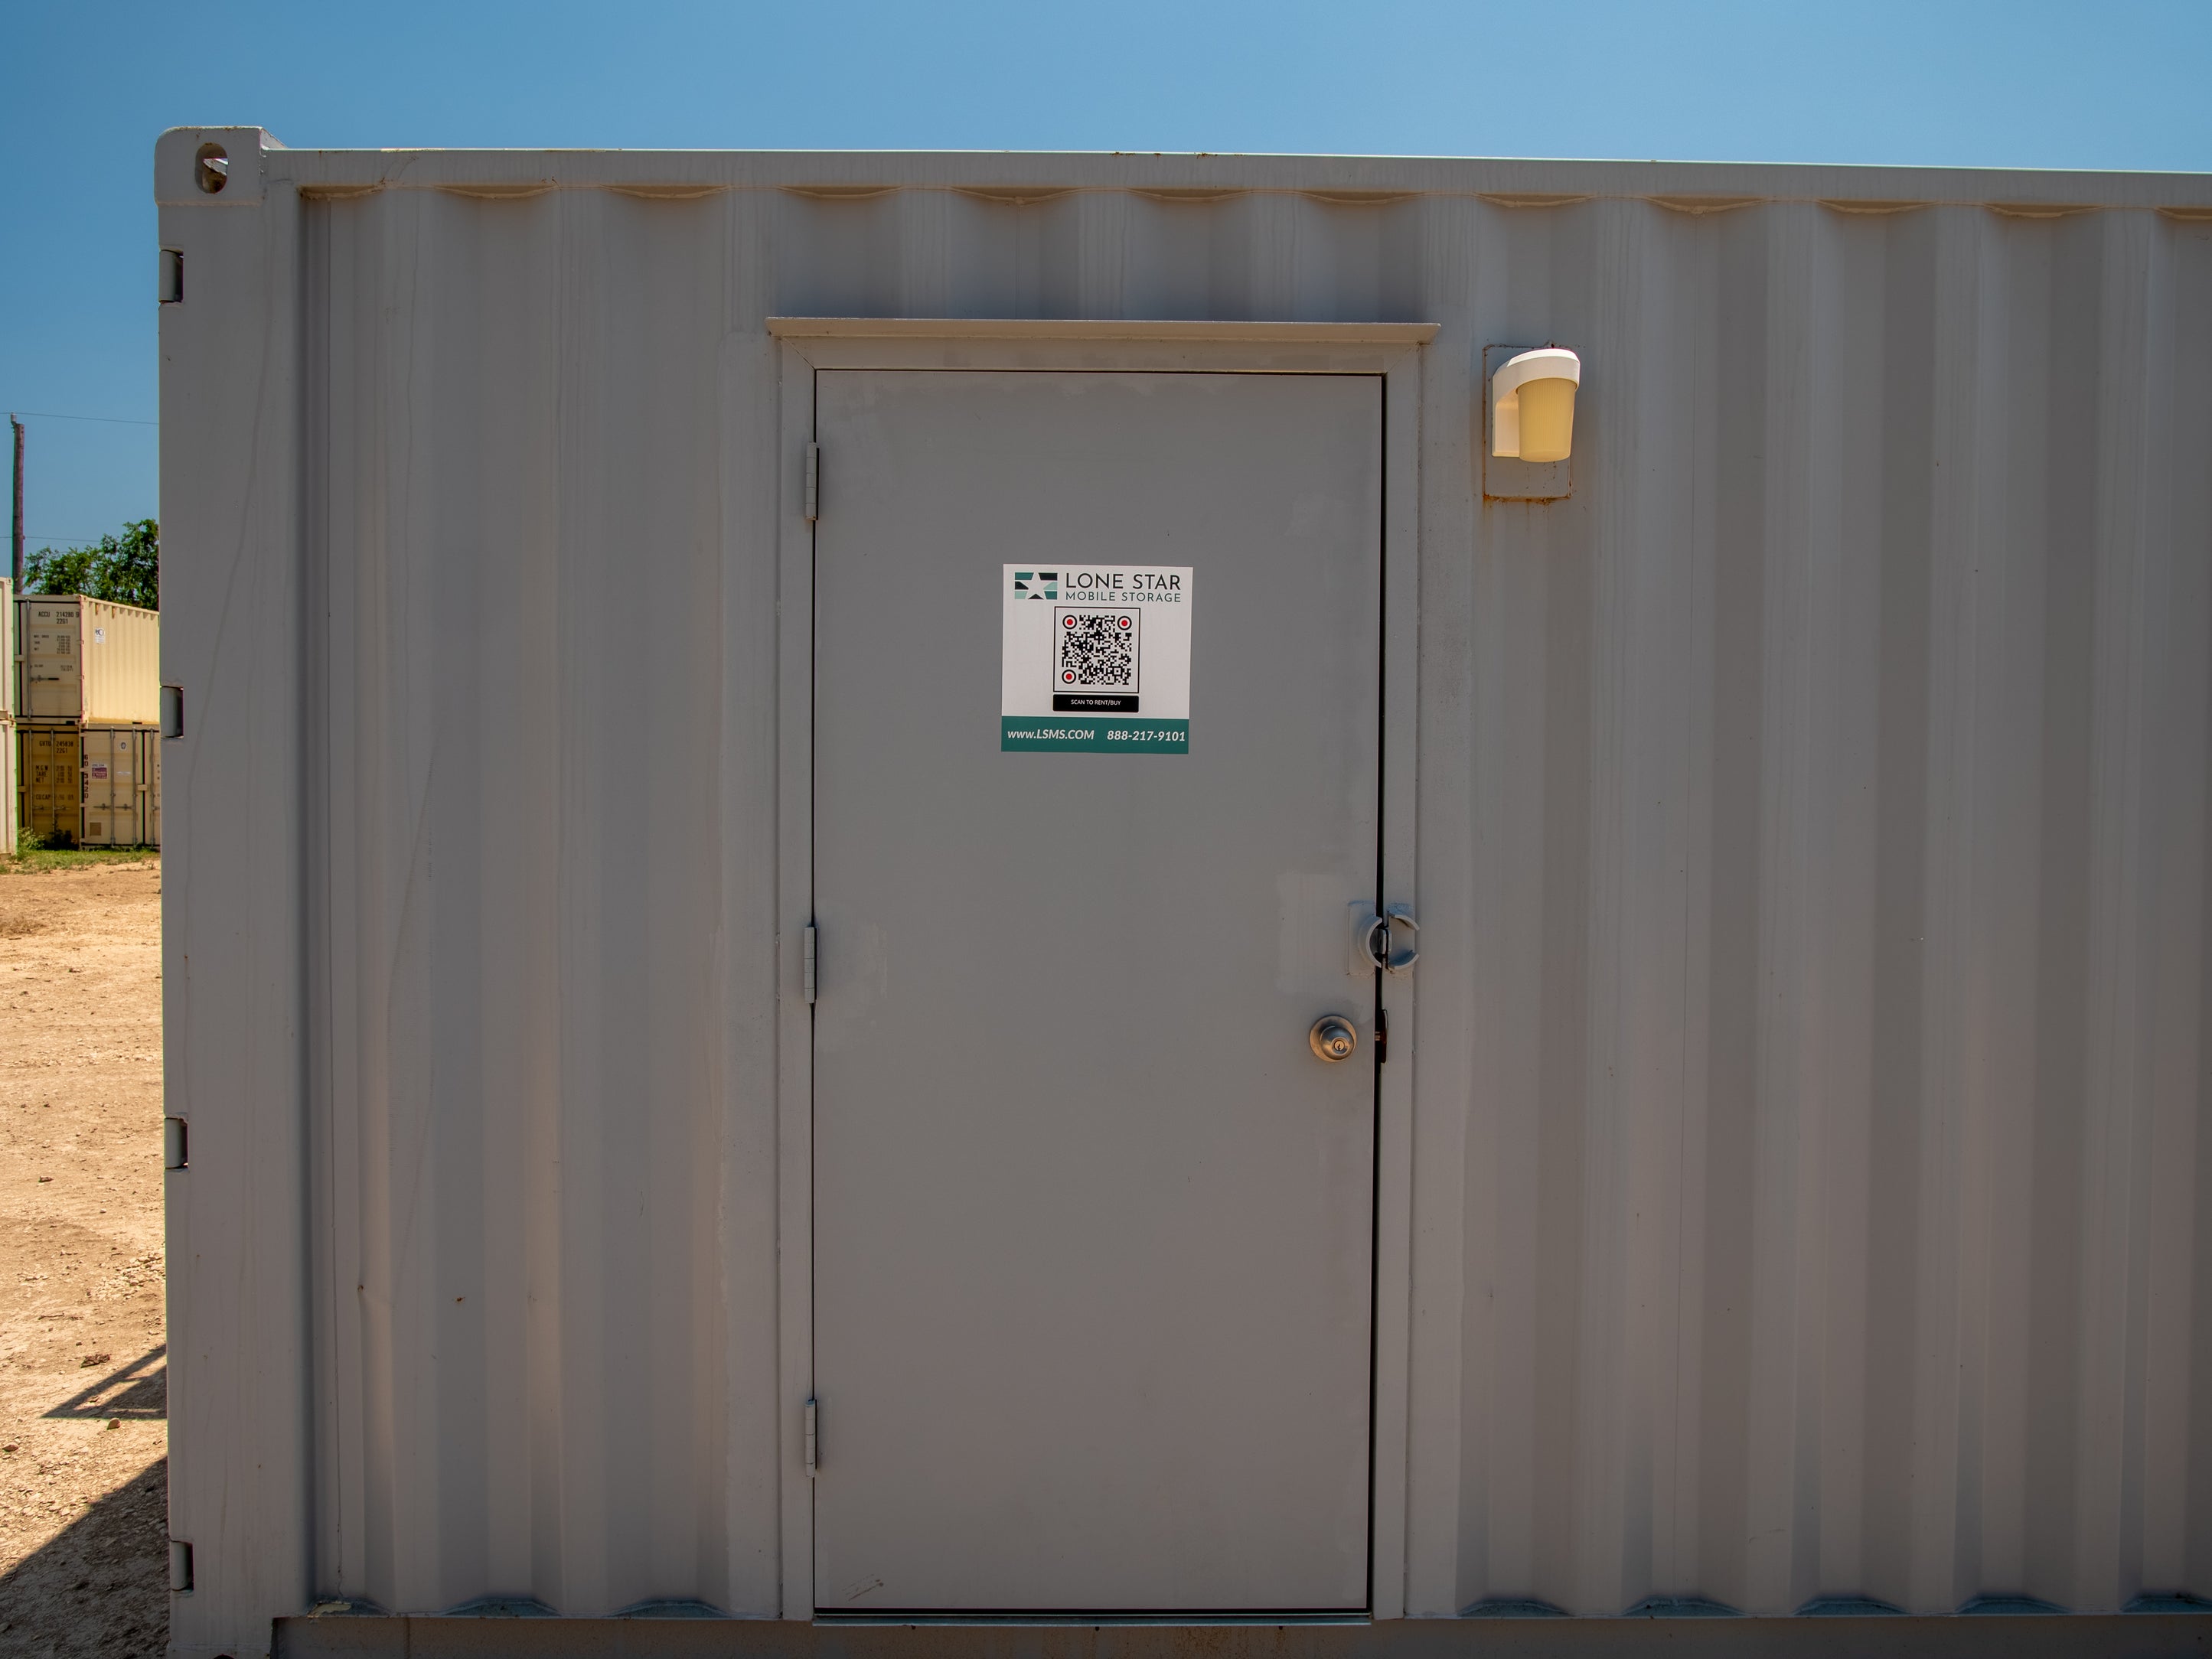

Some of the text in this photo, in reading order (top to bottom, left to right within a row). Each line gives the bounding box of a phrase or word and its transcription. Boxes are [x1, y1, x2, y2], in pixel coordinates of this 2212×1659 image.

[1065, 572, 1181, 590] LONE STAR
[1065, 591, 1181, 602] MOBILE STORAGE
[1007, 728, 1186, 741] www.LSMS.COM 888-217-9101
